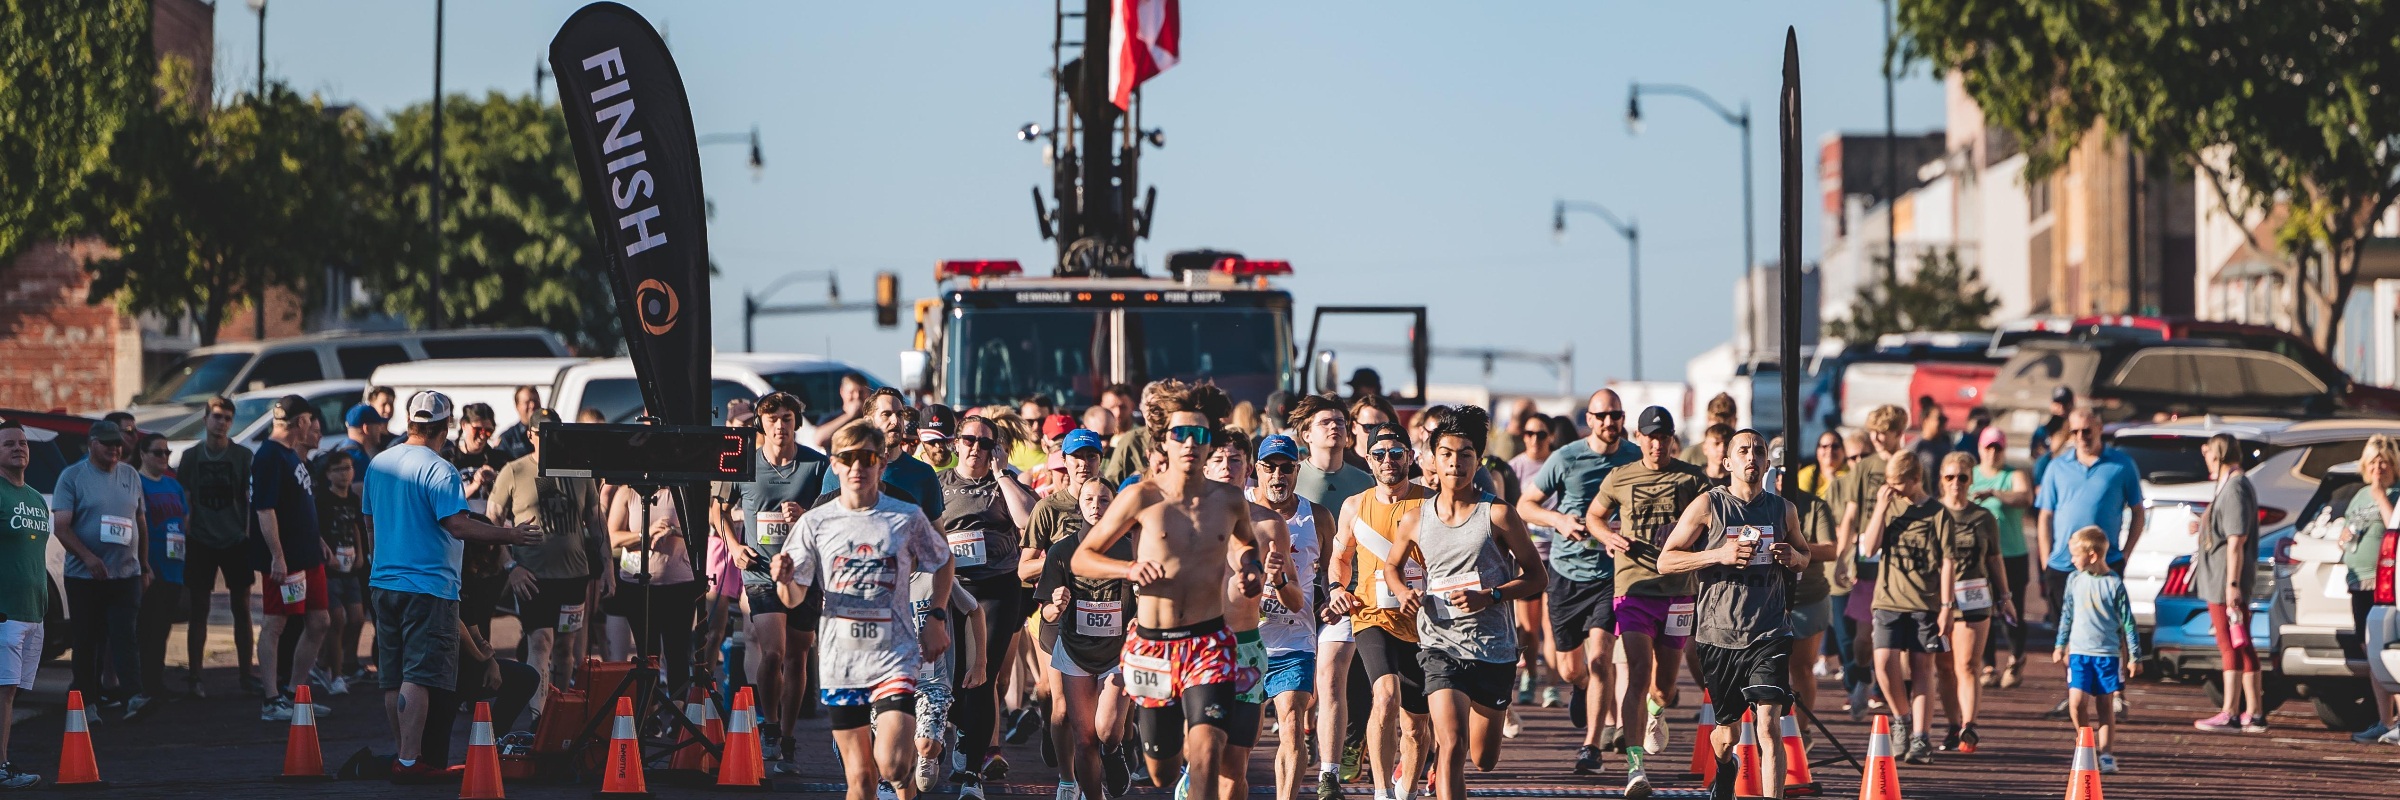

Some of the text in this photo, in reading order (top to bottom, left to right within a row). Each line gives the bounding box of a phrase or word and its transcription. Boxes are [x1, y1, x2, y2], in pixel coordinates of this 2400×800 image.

[582, 46, 667, 257] FINISH
[1016, 291, 1072, 303] SEMINOLE
[1163, 291, 1189, 303] FIRE
[718, 435, 743, 473] 2
[944, 488, 1000, 497] CYCLEBAR
[13, 501, 48, 519] AMEN
[766, 522, 790, 536] 649
[953, 543, 976, 558] 681
[1086, 612, 1113, 628] 652
[850, 622, 878, 639] 618
[1133, 669, 1159, 687] 614
